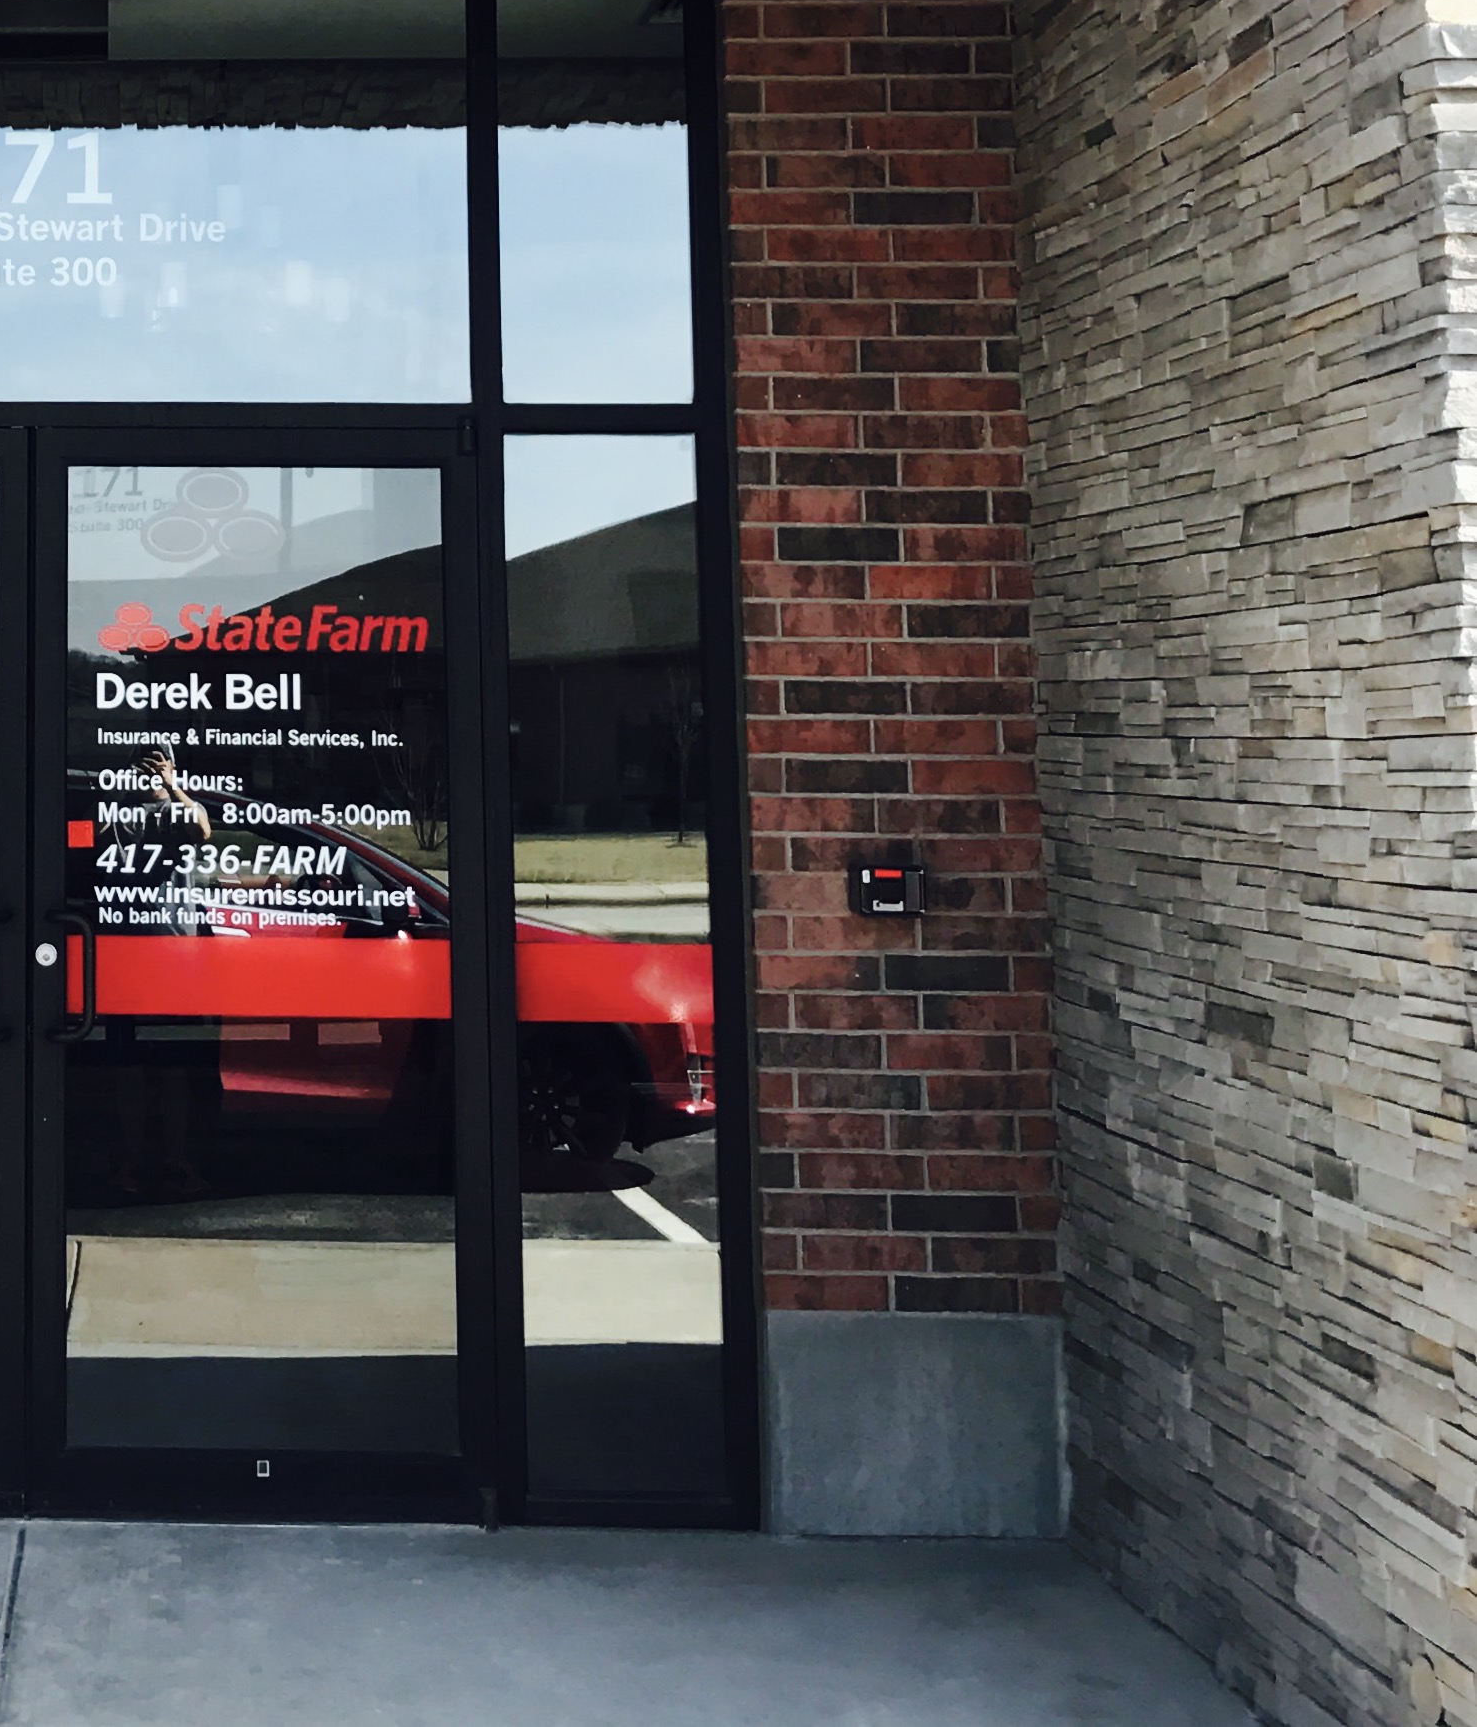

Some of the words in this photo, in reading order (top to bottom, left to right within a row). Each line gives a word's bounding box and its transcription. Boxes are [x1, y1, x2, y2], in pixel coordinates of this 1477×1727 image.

[138, 212, 226, 242] Drive
[49, 257, 117, 287] 300
[96, 672, 213, 710] Derek
[225, 673, 302, 710] Bell
[97, 728, 180, 746] Insurance
[185, 729, 199, 746] &
[205, 728, 282, 747] Financial
[287, 729, 365, 749] Services,
[371, 730, 404, 747] Inc.
[98, 769, 163, 791] Office
[171, 770, 243, 791] Hours:
[97, 802, 146, 824] Mon
[171, 802, 199, 823] Fri
[222, 803, 411, 829] 8:00am-5:00pm
[95, 843, 347, 876] 417-336-FARM
[94, 882, 416, 907] www.insuremissouri.net
[98, 907, 124, 924] No
[129, 907, 171, 924] bank
[176, 908, 225, 925] funds
[230, 912, 253, 925] on
[258, 908, 342, 927] premises.
